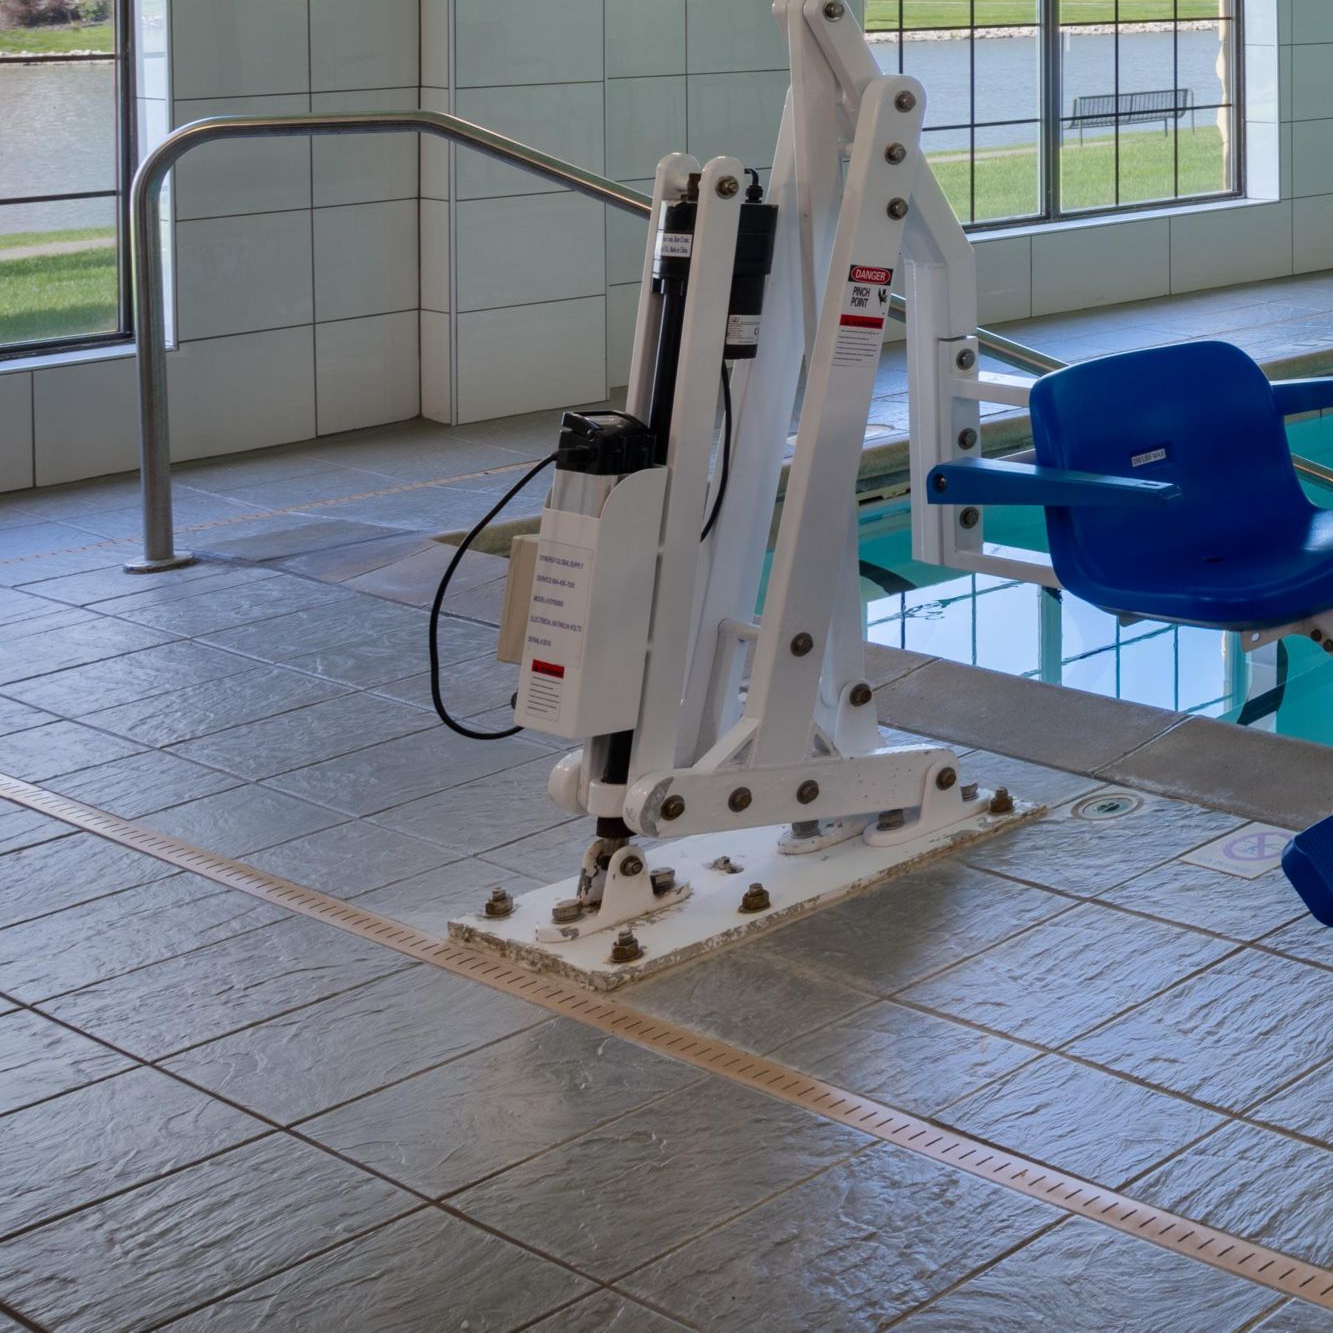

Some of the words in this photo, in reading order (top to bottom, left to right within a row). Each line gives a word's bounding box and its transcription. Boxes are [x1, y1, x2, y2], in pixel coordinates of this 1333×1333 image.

[855, 269, 886, 281] DANGER
[852, 286, 871, 297] PINCH
[850, 297, 869, 308] POINT
